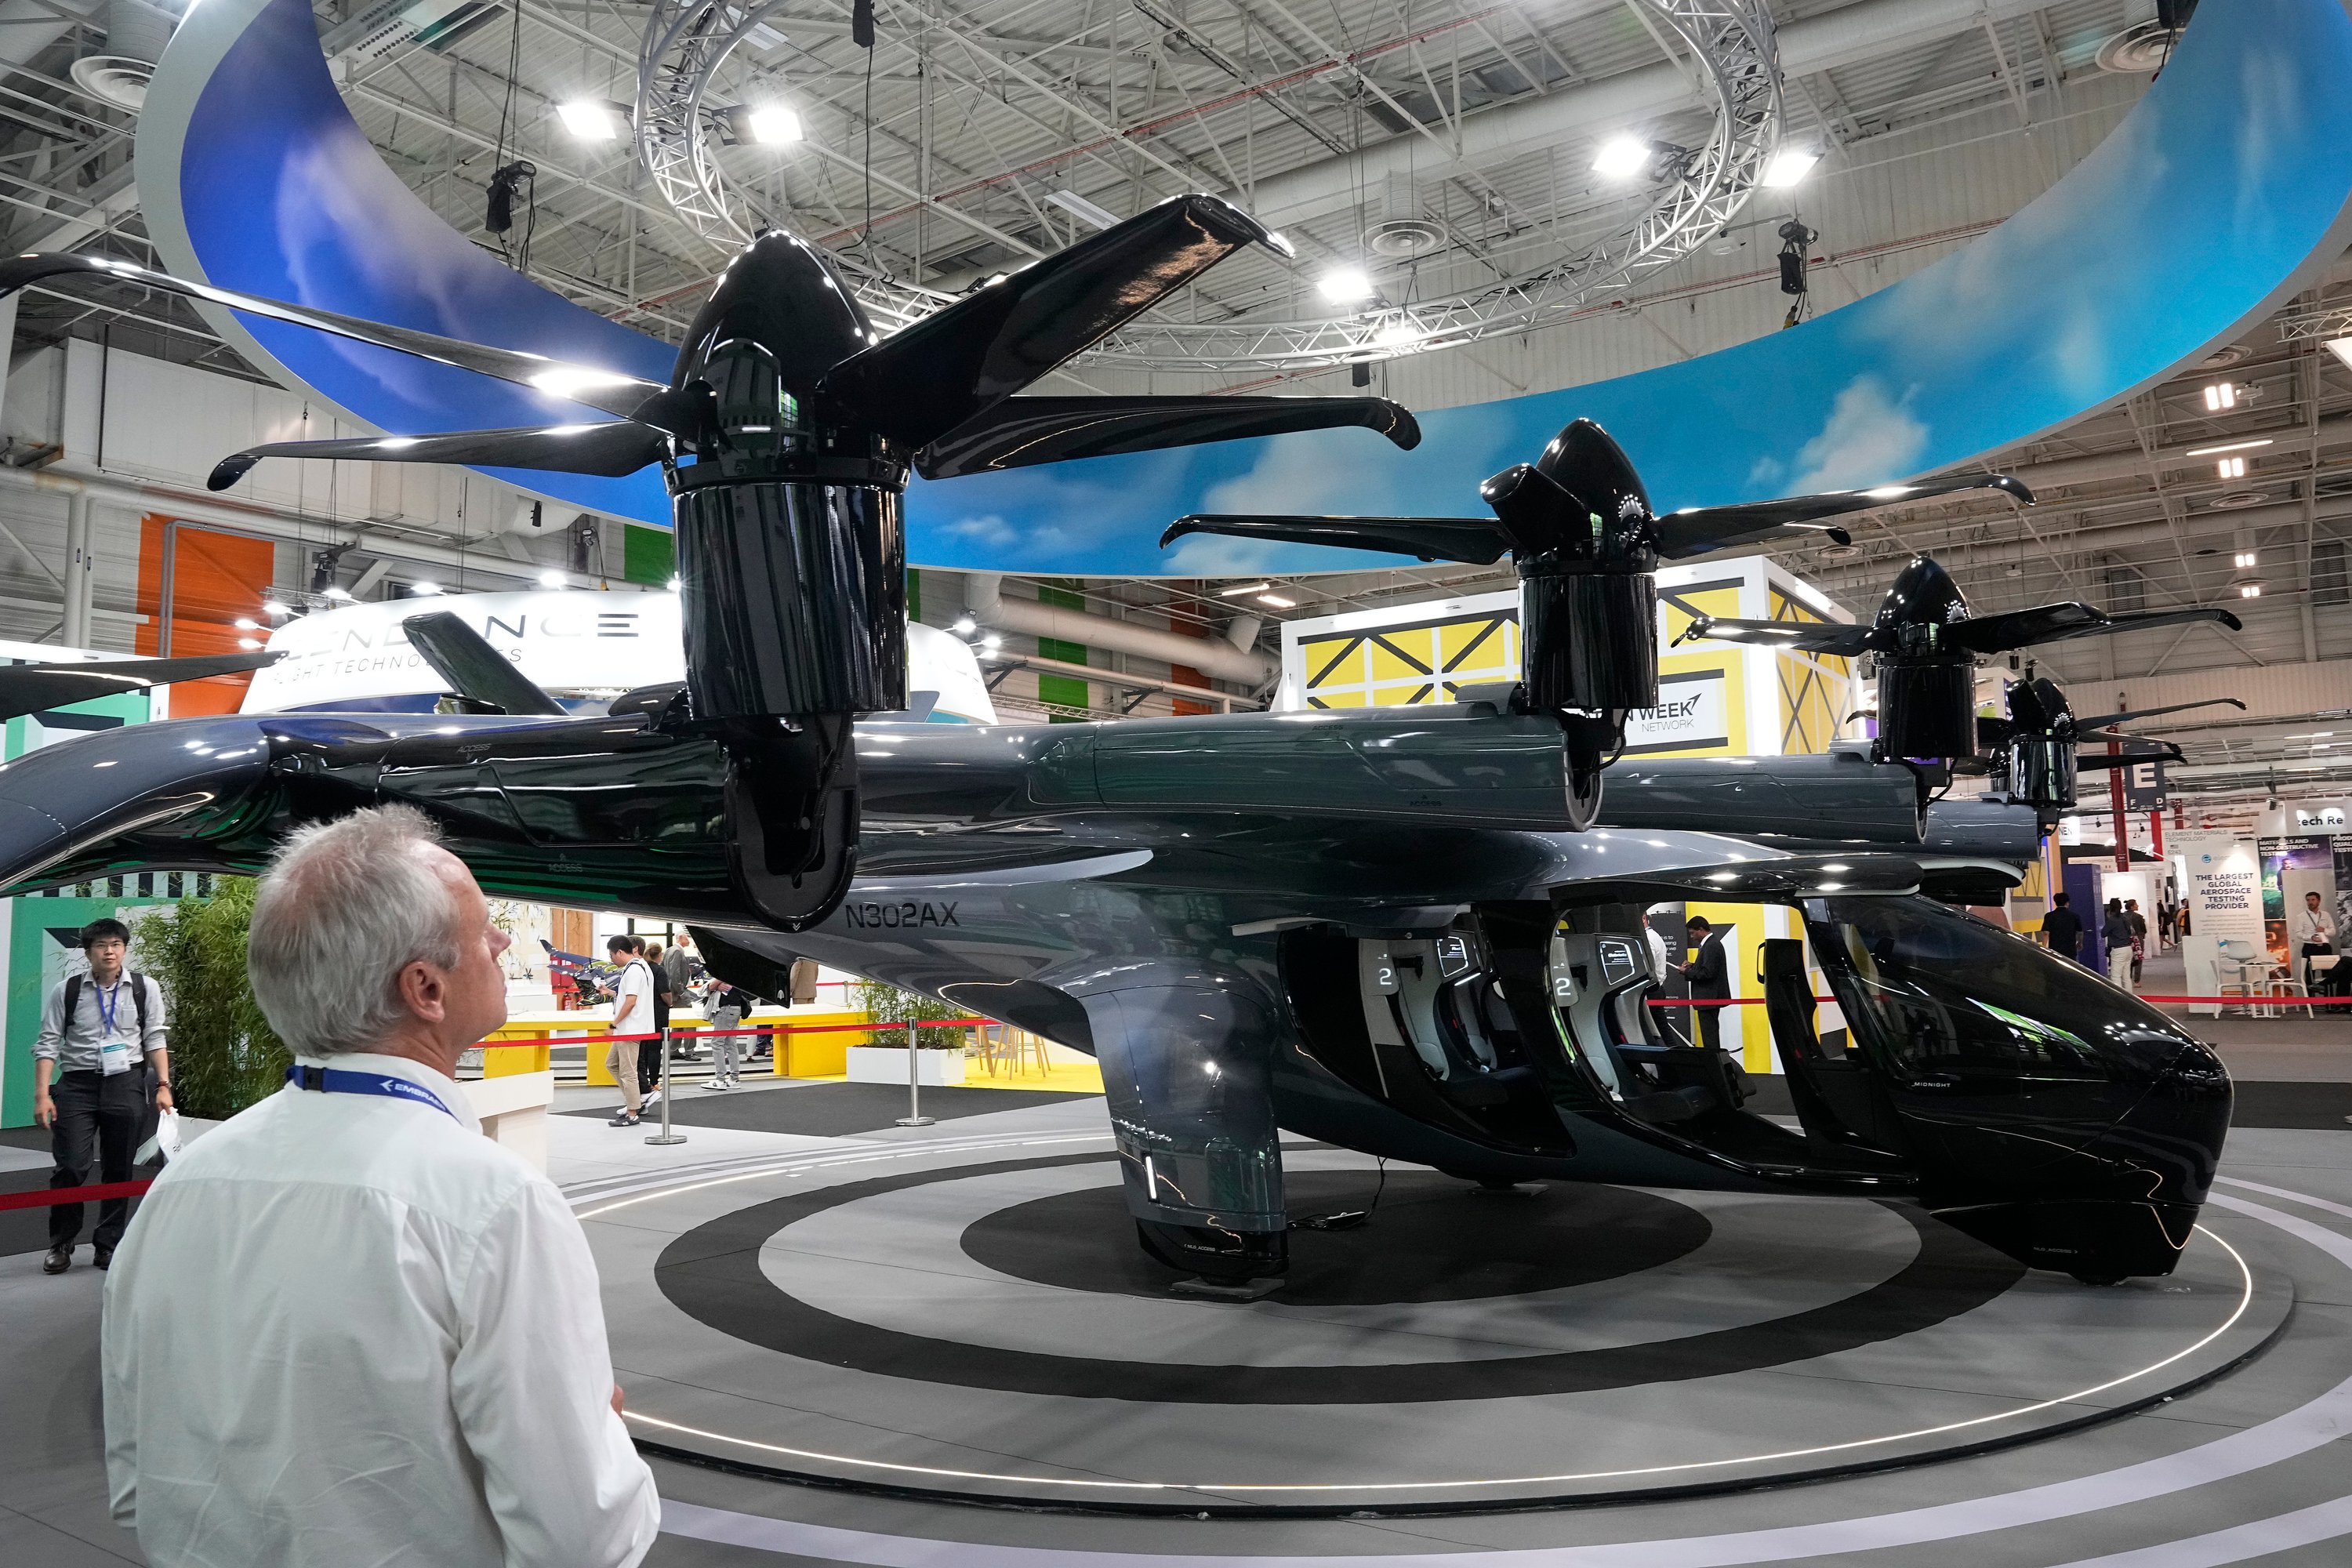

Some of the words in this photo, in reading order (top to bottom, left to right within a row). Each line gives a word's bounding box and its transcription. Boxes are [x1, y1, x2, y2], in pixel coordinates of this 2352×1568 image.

[1639, 701, 1693, 720] WEEK
[1642, 719, 1694, 732] NETWORK
[457, 743, 492, 753] ACCESS
[2132, 762, 2158, 789] E
[845, 902, 960, 928] N302AX
[1379, 967, 1392, 985] 2
[1555, 977, 1571, 996] 2
